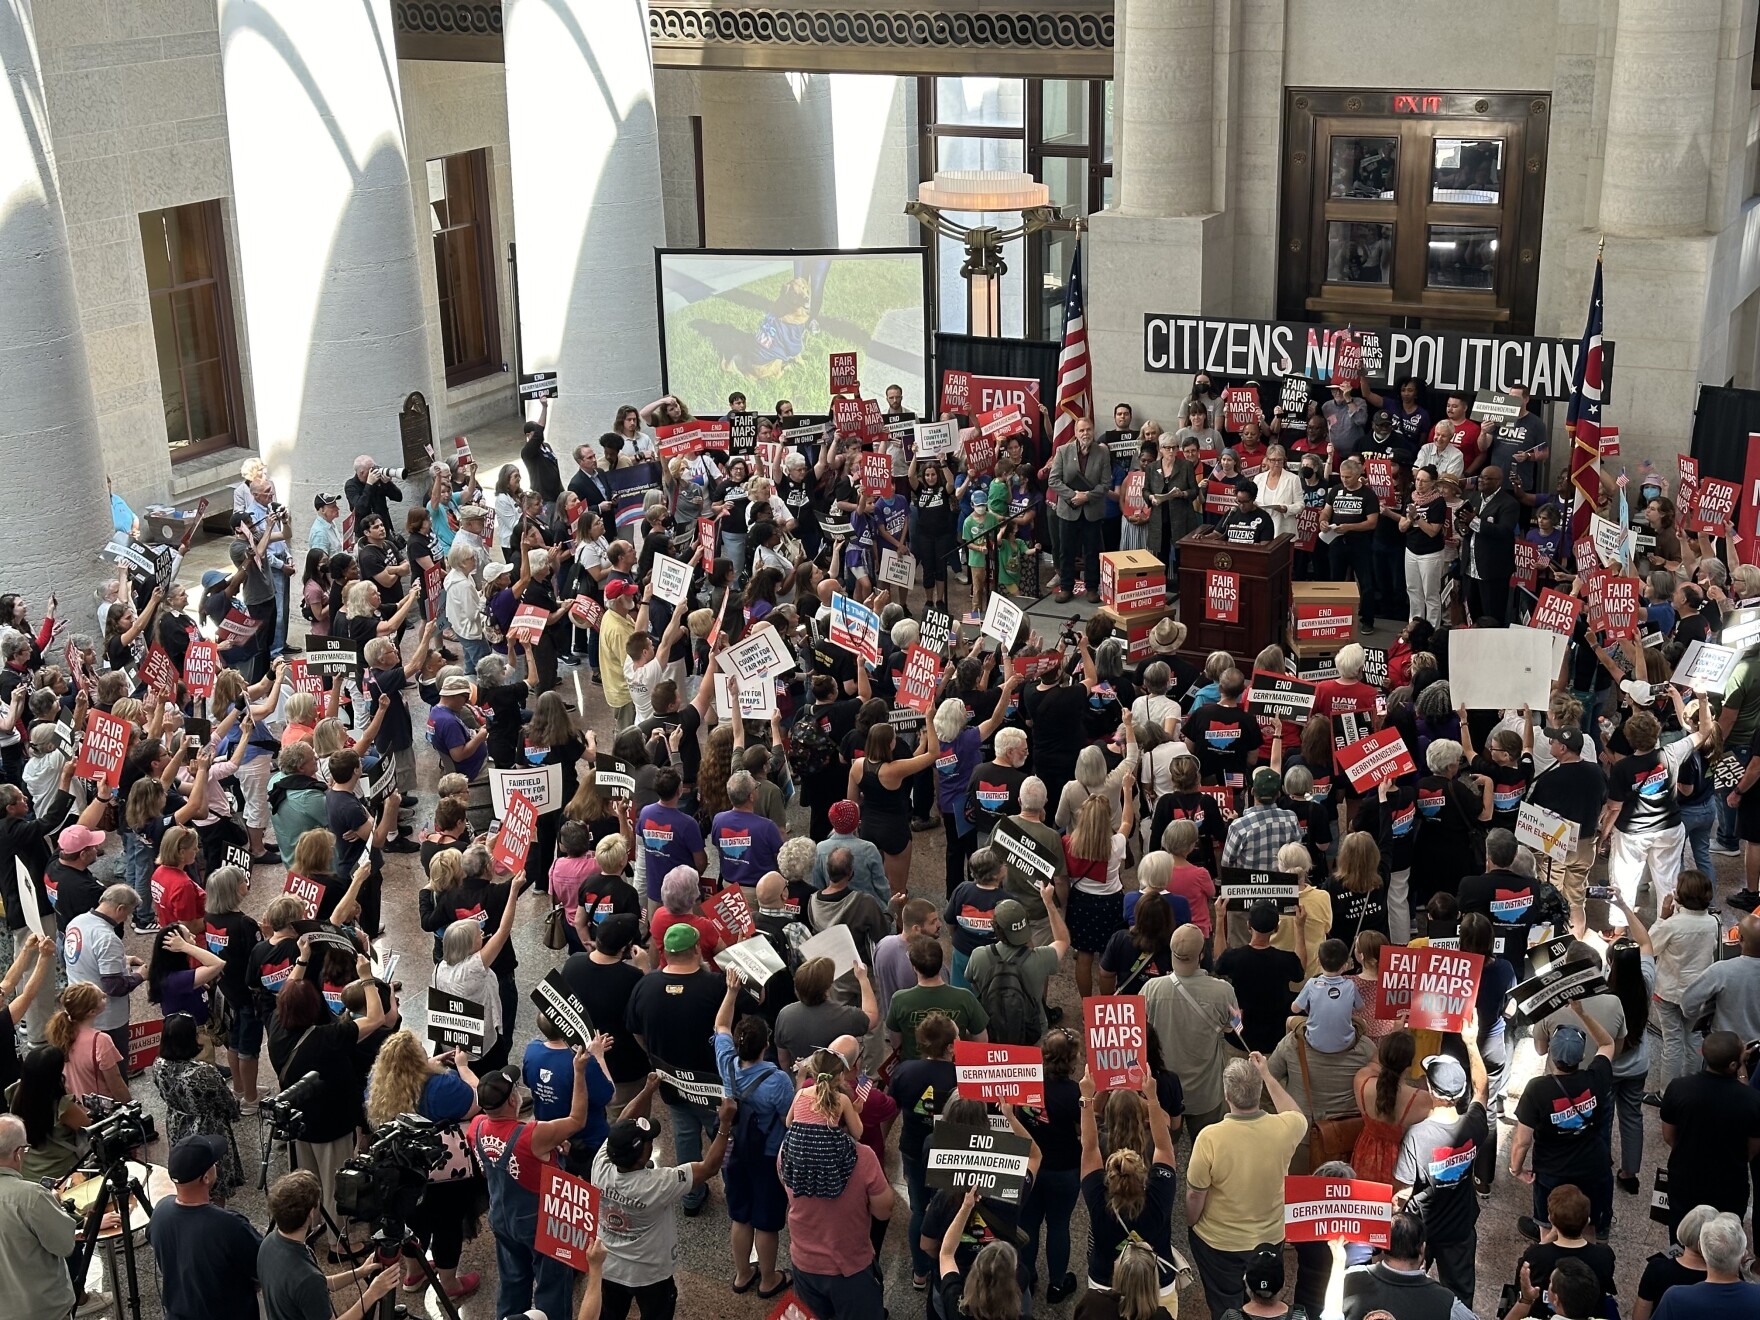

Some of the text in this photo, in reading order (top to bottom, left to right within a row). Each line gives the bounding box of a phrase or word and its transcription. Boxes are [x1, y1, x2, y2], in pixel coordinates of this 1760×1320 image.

[1394, 95, 1441, 114] EXIT
[1362, 335, 1379, 347] FAIR
[1148, 319, 1293, 377] CITIZENS
[1388, 334, 1604, 397] POLITICIAN
[1360, 346, 1383, 358] MAPS
[834, 356, 852, 366] FAIR
[1362, 357, 1382, 369] NOW
[832, 365, 855, 376] MAPS
[834, 376, 853, 385] NOW
[949, 374, 967, 385] FAIR
[1286, 378, 1306, 392] FAIR
[944, 384, 969, 396] MAPS
[1232, 392, 1252, 402] FAIR
[1282, 390, 1307, 402] MAPS
[840, 403, 858, 412] FAIR
[946, 395, 966, 406] NOW
[1282, 400, 1304, 412] NOW
[734, 416, 753, 426] FAIR
[731, 426, 755, 437] MAPS
[1498, 426, 1526, 439] ONE
[734, 437, 753, 447] NOW
[970, 438, 989, 450] FAIR
[867, 456, 886, 466] FAIR
[969, 450, 994, 463] MAPS
[1370, 464, 1387, 474] FAIR
[1369, 475, 1391, 486] MAPS
[1706, 483, 1733, 499] FAIR
[1333, 501, 1362, 509] CITIZENS
[1699, 498, 1732, 513] MAPS
[1698, 511, 1724, 524] NOW
[1515, 544, 1532, 556] FAIR
[156, 551, 171, 567] FAIR
[667, 565, 680, 574] SUMMIT
[662, 572, 675, 583] COUNTY
[1136, 580, 1147, 588] END
[1212, 575, 1233, 588] FAIR
[1209, 586, 1236, 599] MAPS
[1607, 584, 1632, 598] FAIR
[577, 598, 591, 616] FAIR
[1137, 598, 1152, 608] OHIO
[1211, 598, 1233, 611] NOW
[1545, 595, 1574, 615] FAIR
[1605, 598, 1635, 612] MAPS
[926, 610, 949, 626] FAIR
[1536, 610, 1572, 630] MAPS
[1608, 614, 1630, 627] NOW
[920, 623, 950, 641] MAPS
[190, 646, 211, 658] FAIR
[327, 641, 340, 649] END
[740, 643, 759, 657] SUMMIT
[919, 637, 944, 653] NOW
[738, 647, 769, 666] COUNTY FOR
[912, 650, 935, 670] FAIR
[186, 660, 213, 673] MAPS
[324, 664, 346, 673] IN OHIO
[745, 656, 772, 672] FAIR MAPS
[1319, 660, 1332, 668] END
[188, 674, 210, 685] NOW
[905, 666, 935, 688] MAPS
[296, 678, 322, 692] MAPS
[905, 680, 932, 700] NOW
[1275, 680, 1292, 690] END
[1253, 691, 1310, 704] GERRYMANDERING
[95, 717, 124, 737] FAIR
[87, 731, 124, 758] MAPS
[1362, 739, 1379, 754] END
[87, 751, 118, 772] NOW
[1351, 743, 1401, 776] GERRYMANDERING
[615, 762, 626, 772] END
[1371, 761, 1398, 781] IN OHIO
[509, 778, 541, 787] FAIRFIELD
[506, 786, 545, 797] CONTY FOR
[514, 801, 532, 821] FAIR
[1519, 810, 1538, 825] FAITH
[507, 817, 531, 845] MAPS
[1517, 821, 1567, 851] FAIR ELECTIONS
[502, 834, 525, 859] NOW
[1021, 835, 1036, 850] END
[227, 846, 250, 866] FAIR
[1000, 834, 1050, 872] GERRYMANDERING
[1006, 853, 1034, 876] IN OHIO
[1250, 874, 1269, 884] END
[290, 877, 319, 900] FAIR
[1227, 886, 1293, 896] GERRYMANDERING
[721, 893, 750, 934] MAPS
[733, 891, 751, 925] FAIR
[714, 902, 740, 934] NOW
[1012, 918, 1027, 931] CLE
[1550, 942, 1566, 956] END
[1429, 954, 1471, 977] FAIR
[1419, 974, 1473, 997] MAPS
[568, 993, 584, 1014] END
[1549, 985, 1585, 1008] IN OHIO
[450, 1001, 463, 1013] END
[1421, 994, 1466, 1015] NOW
[542, 985, 590, 1042] GERRYMANDERING
[1094, 1004, 1135, 1025] FAIR
[432, 1014, 480, 1031] GERRYMANDERING
[545, 1006, 575, 1038] IN OHIO
[444, 1030, 469, 1045] IN OHIO
[1090, 1027, 1142, 1049] MAPS
[988, 1051, 1008, 1062] END
[676, 1070, 694, 1080] END
[962, 1067, 1037, 1079] GERRYMANDERING
[661, 1072, 722, 1093] GERRYMANDERING
[1551, 1098, 1596, 1123] FAIR DISTRICTS
[969, 1135, 993, 1149] END
[936, 1154, 1020, 1170] GERRYMANDERING
[1431, 1148, 1475, 1173] FAIR DISTRICTS
[953, 1172, 996, 1188] IN OHIO
[551, 1175, 590, 1210] FAIR
[1325, 1184, 1351, 1198] END
[544, 1194, 594, 1232] MAPS
[1292, 1204, 1383, 1217] GERRYMANDERING
[546, 1217, 588, 1250] NOW
[1315, 1221, 1360, 1236] IN OHIO
